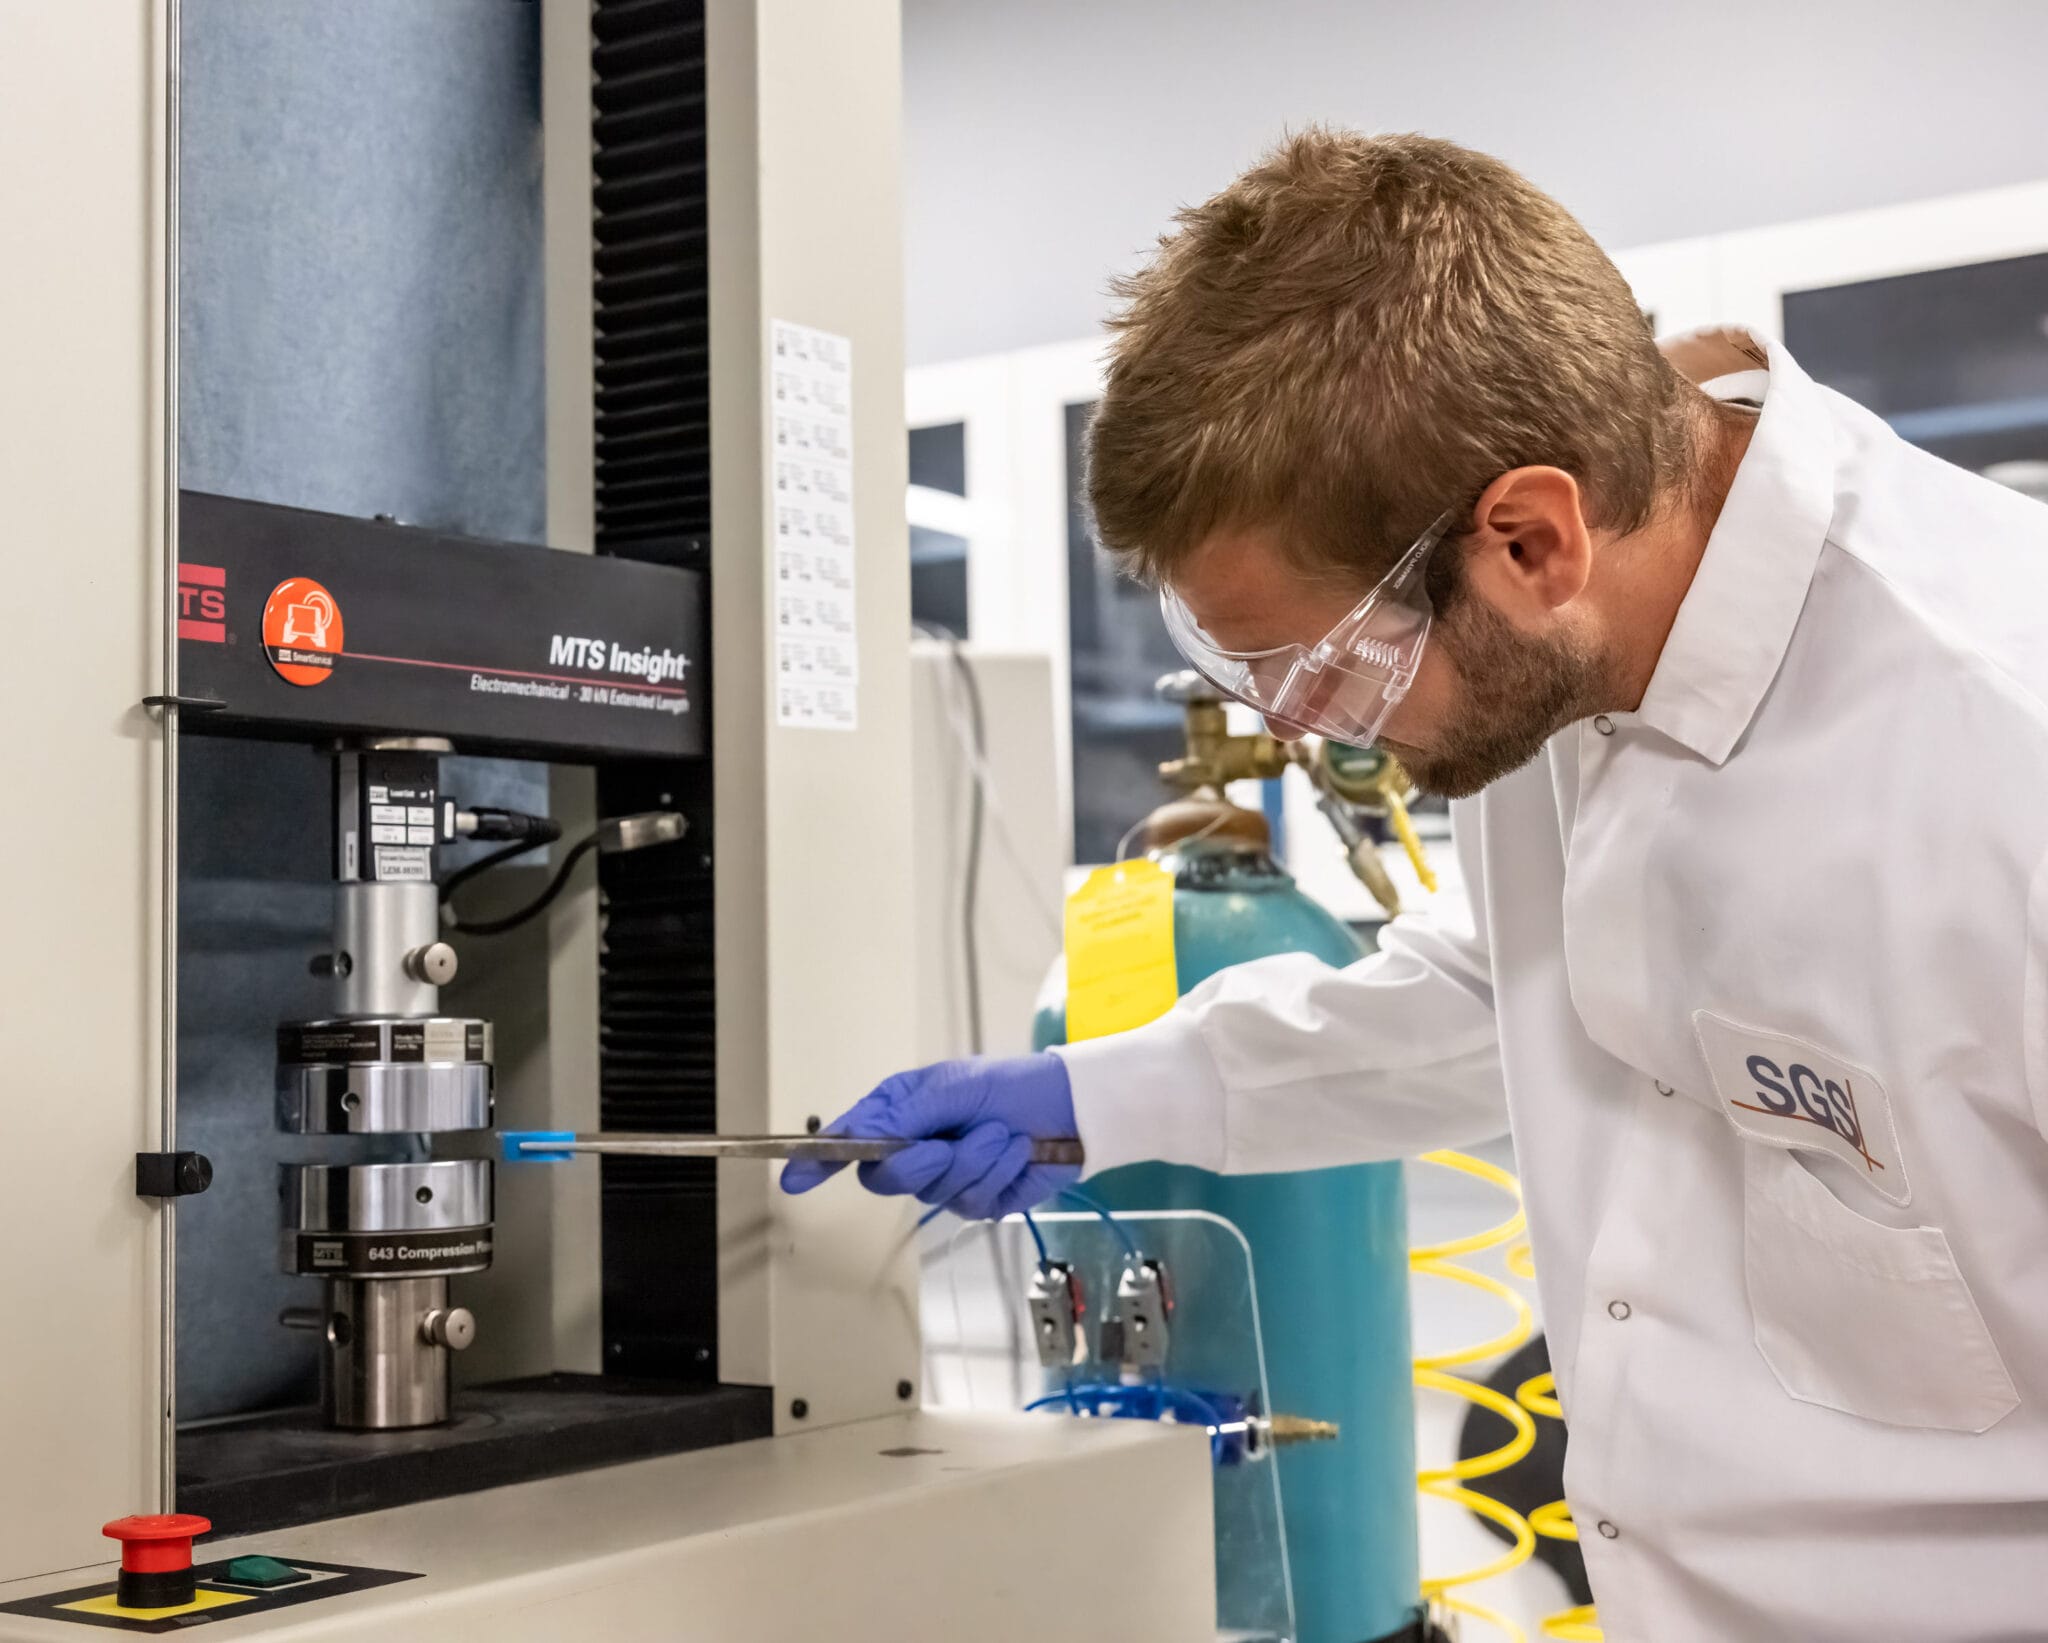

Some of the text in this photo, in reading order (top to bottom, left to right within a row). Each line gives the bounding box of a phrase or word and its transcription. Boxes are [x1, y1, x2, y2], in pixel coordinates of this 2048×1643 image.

[178, 587, 225, 619] TS
[550, 635, 685, 683] MTS Insight
[470, 673, 570, 700] Electromechanical
[1746, 1055, 1861, 1148] SGS
[368, 1247, 394, 1261] 643
[398, 1243, 476, 1261] Compression
